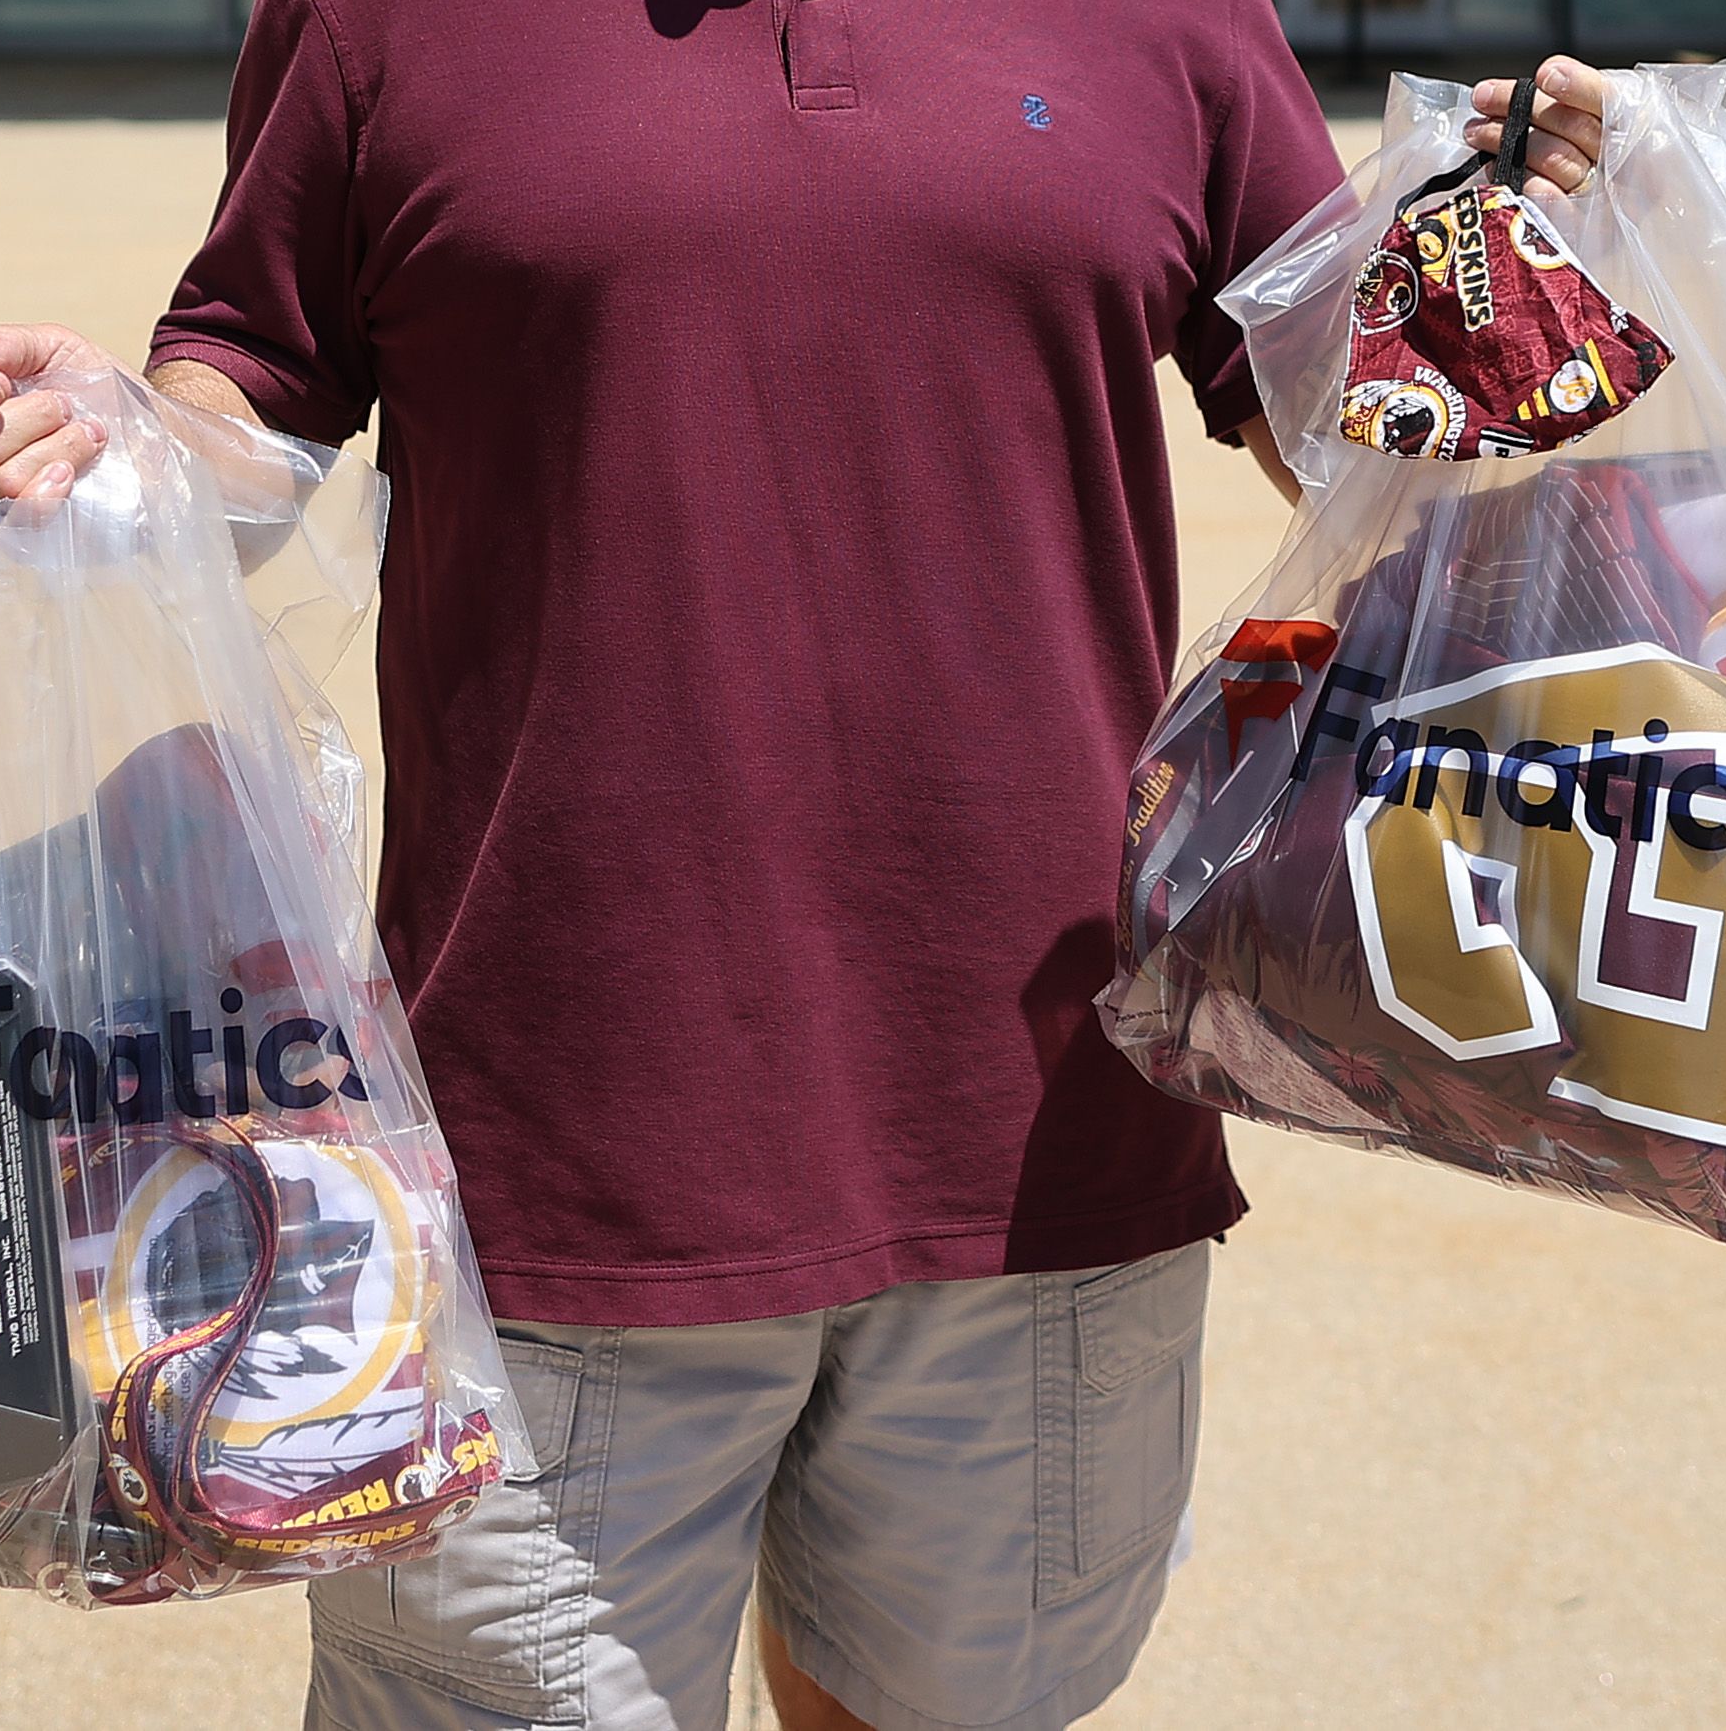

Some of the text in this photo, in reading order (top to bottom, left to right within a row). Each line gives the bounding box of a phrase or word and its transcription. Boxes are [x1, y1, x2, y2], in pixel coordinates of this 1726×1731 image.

[2, 1235, 11, 1260] INC.
[161, 1370, 176, 1396] bag
[181, 1371, 191, 1394] use
[233, 1518, 417, 1554] REDSKINS
